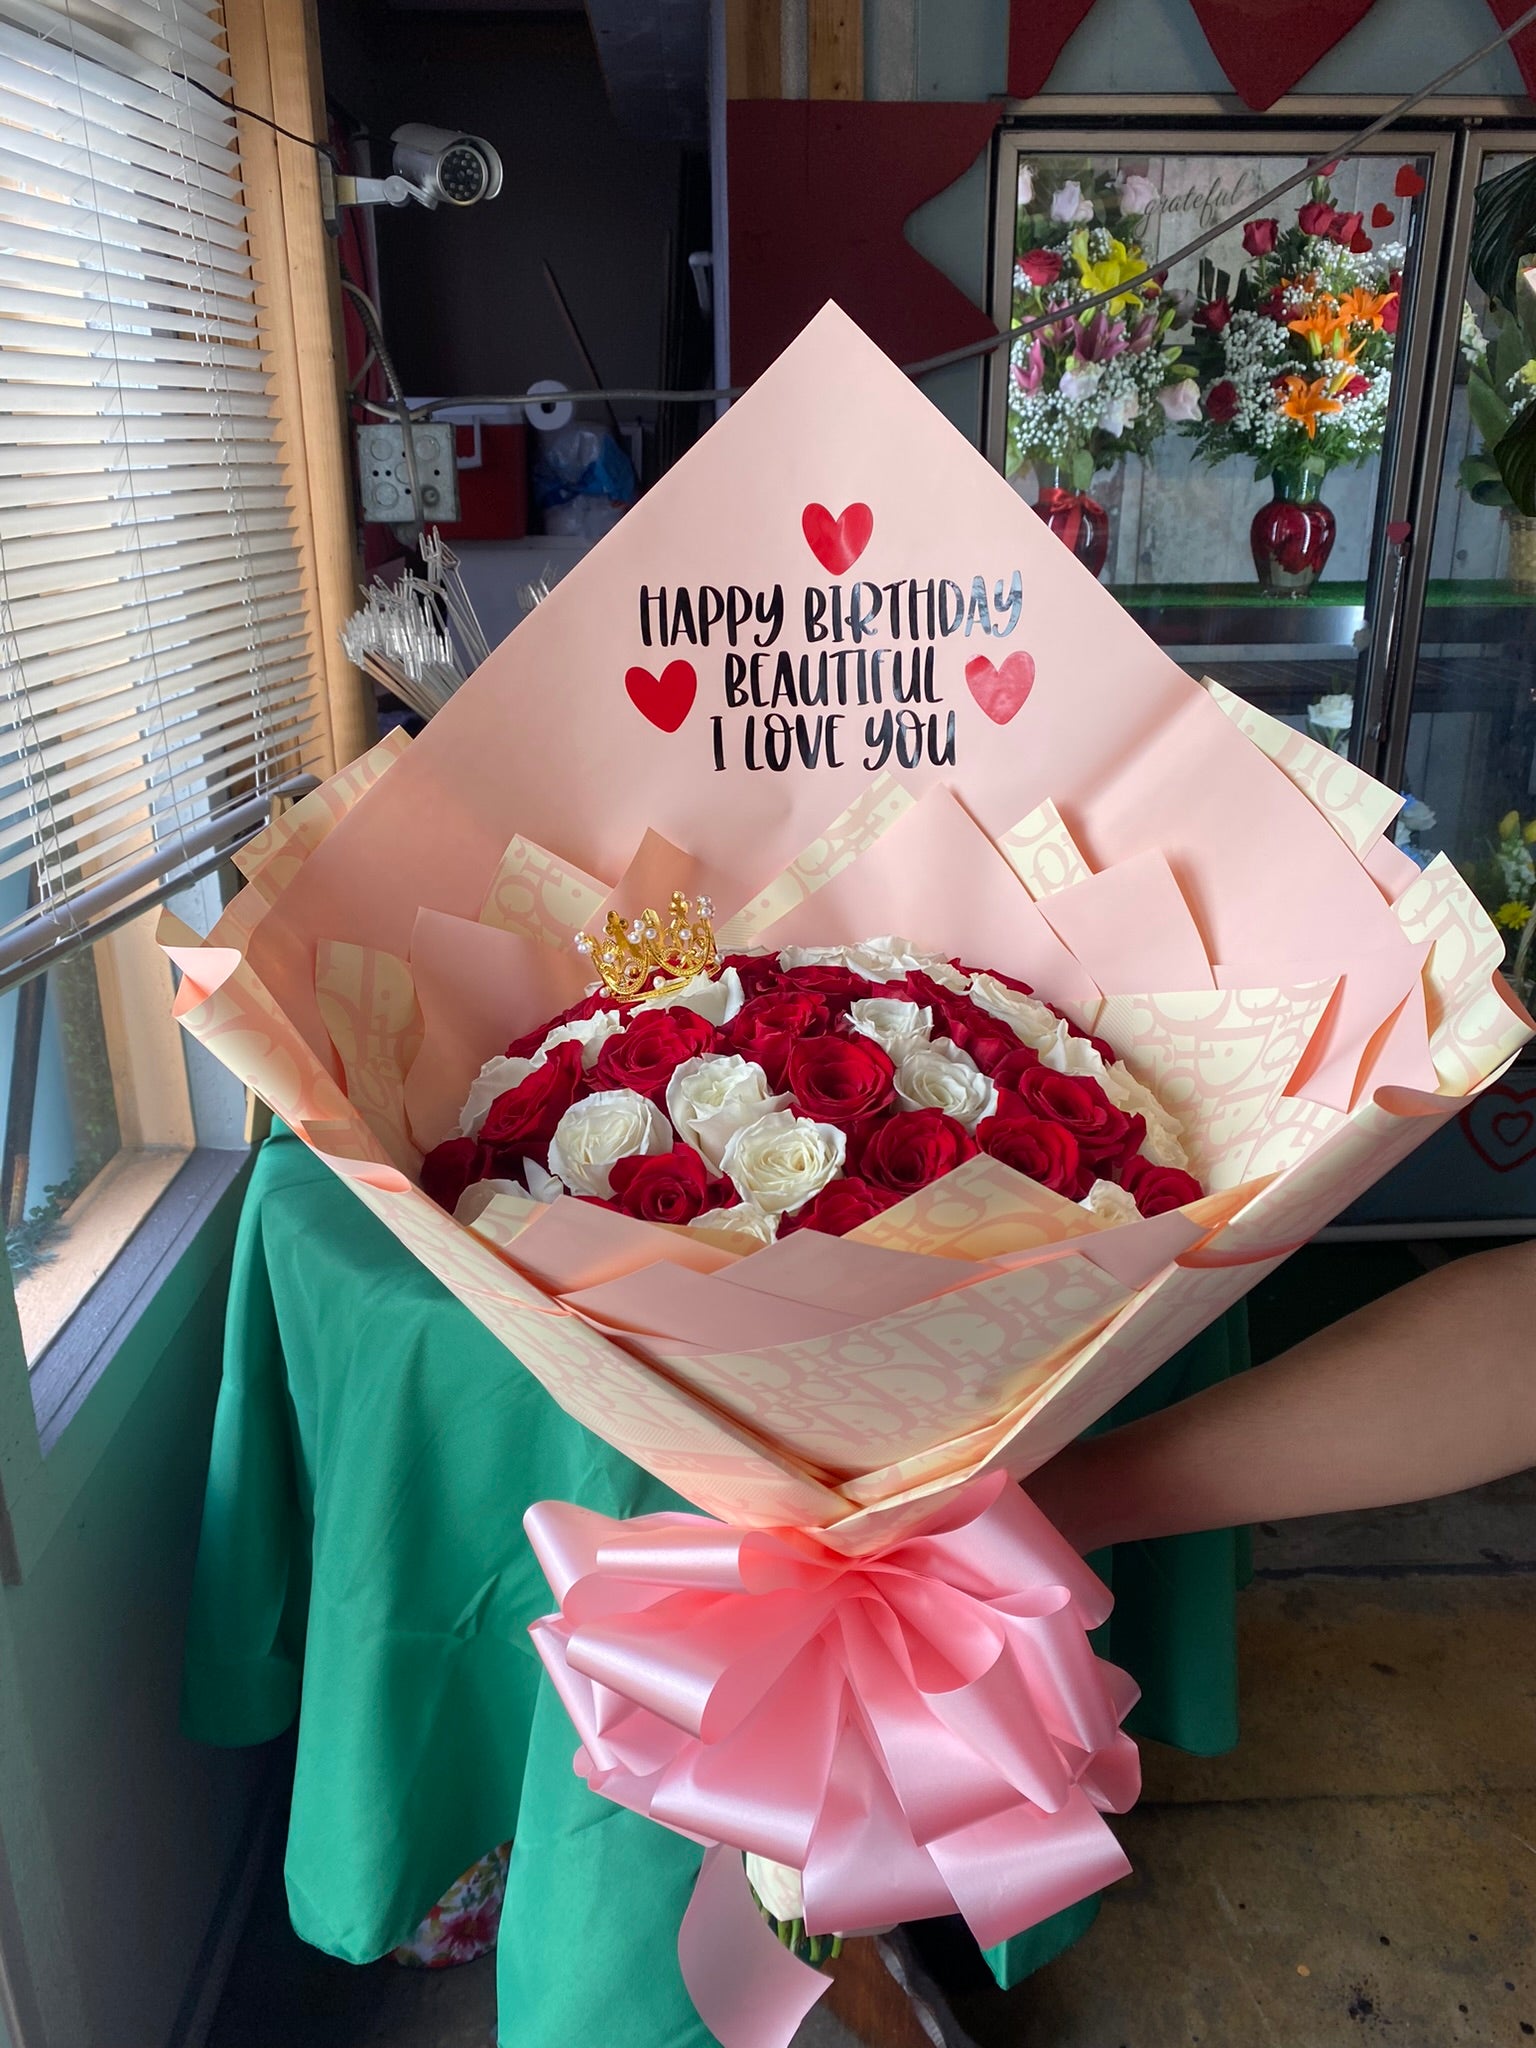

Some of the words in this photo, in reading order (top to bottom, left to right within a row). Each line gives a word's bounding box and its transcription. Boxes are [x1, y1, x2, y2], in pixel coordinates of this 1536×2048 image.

[1133, 171, 1249, 240] grateful
[639, 583, 785, 648] HAPPY
[803, 570, 1023, 645] BIRTHDAY
[724, 645, 944, 709] BEAUTIFUL
[709, 715, 728, 772] I
[744, 712, 846, 773] LOVE
[862, 708, 957, 772] YOU
